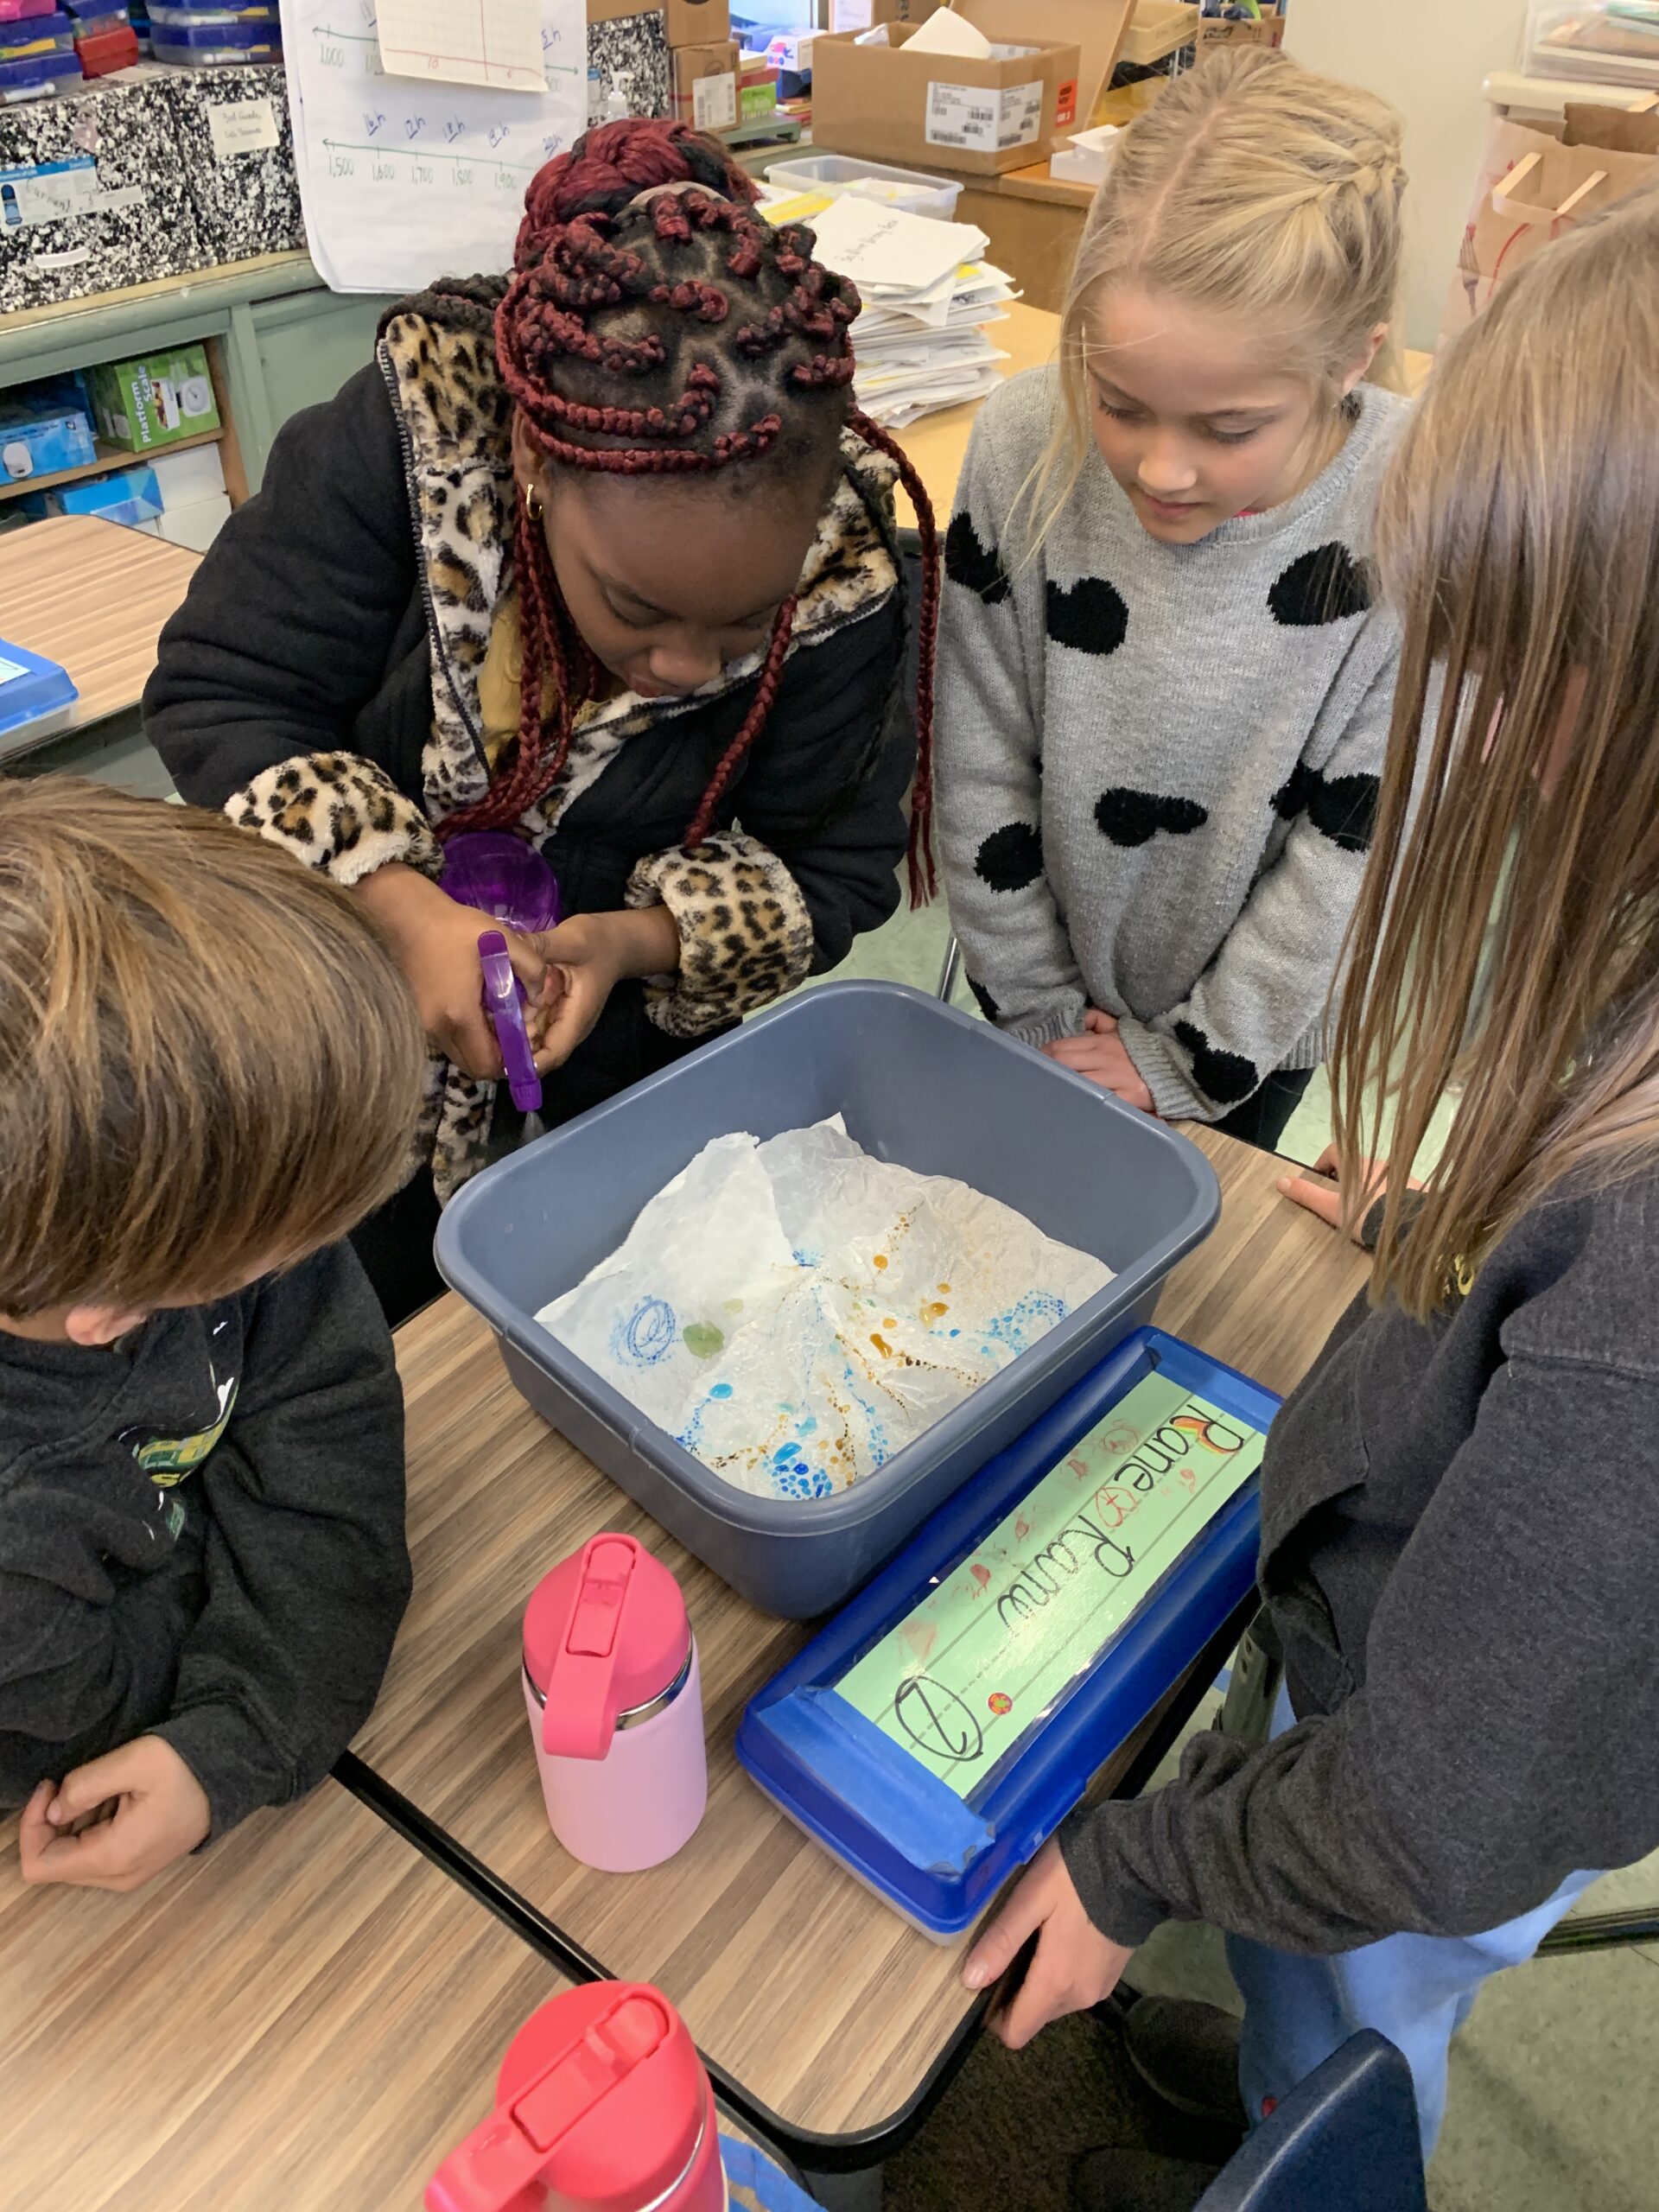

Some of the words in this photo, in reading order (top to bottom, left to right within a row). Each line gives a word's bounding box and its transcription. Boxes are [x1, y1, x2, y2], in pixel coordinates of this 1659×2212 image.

[328, 154, 354, 178] 1,500
[137, 365, 153, 403] Scale
[130, 381, 152, 443] Platform
[1113, 1402, 1247, 1493] Rane
